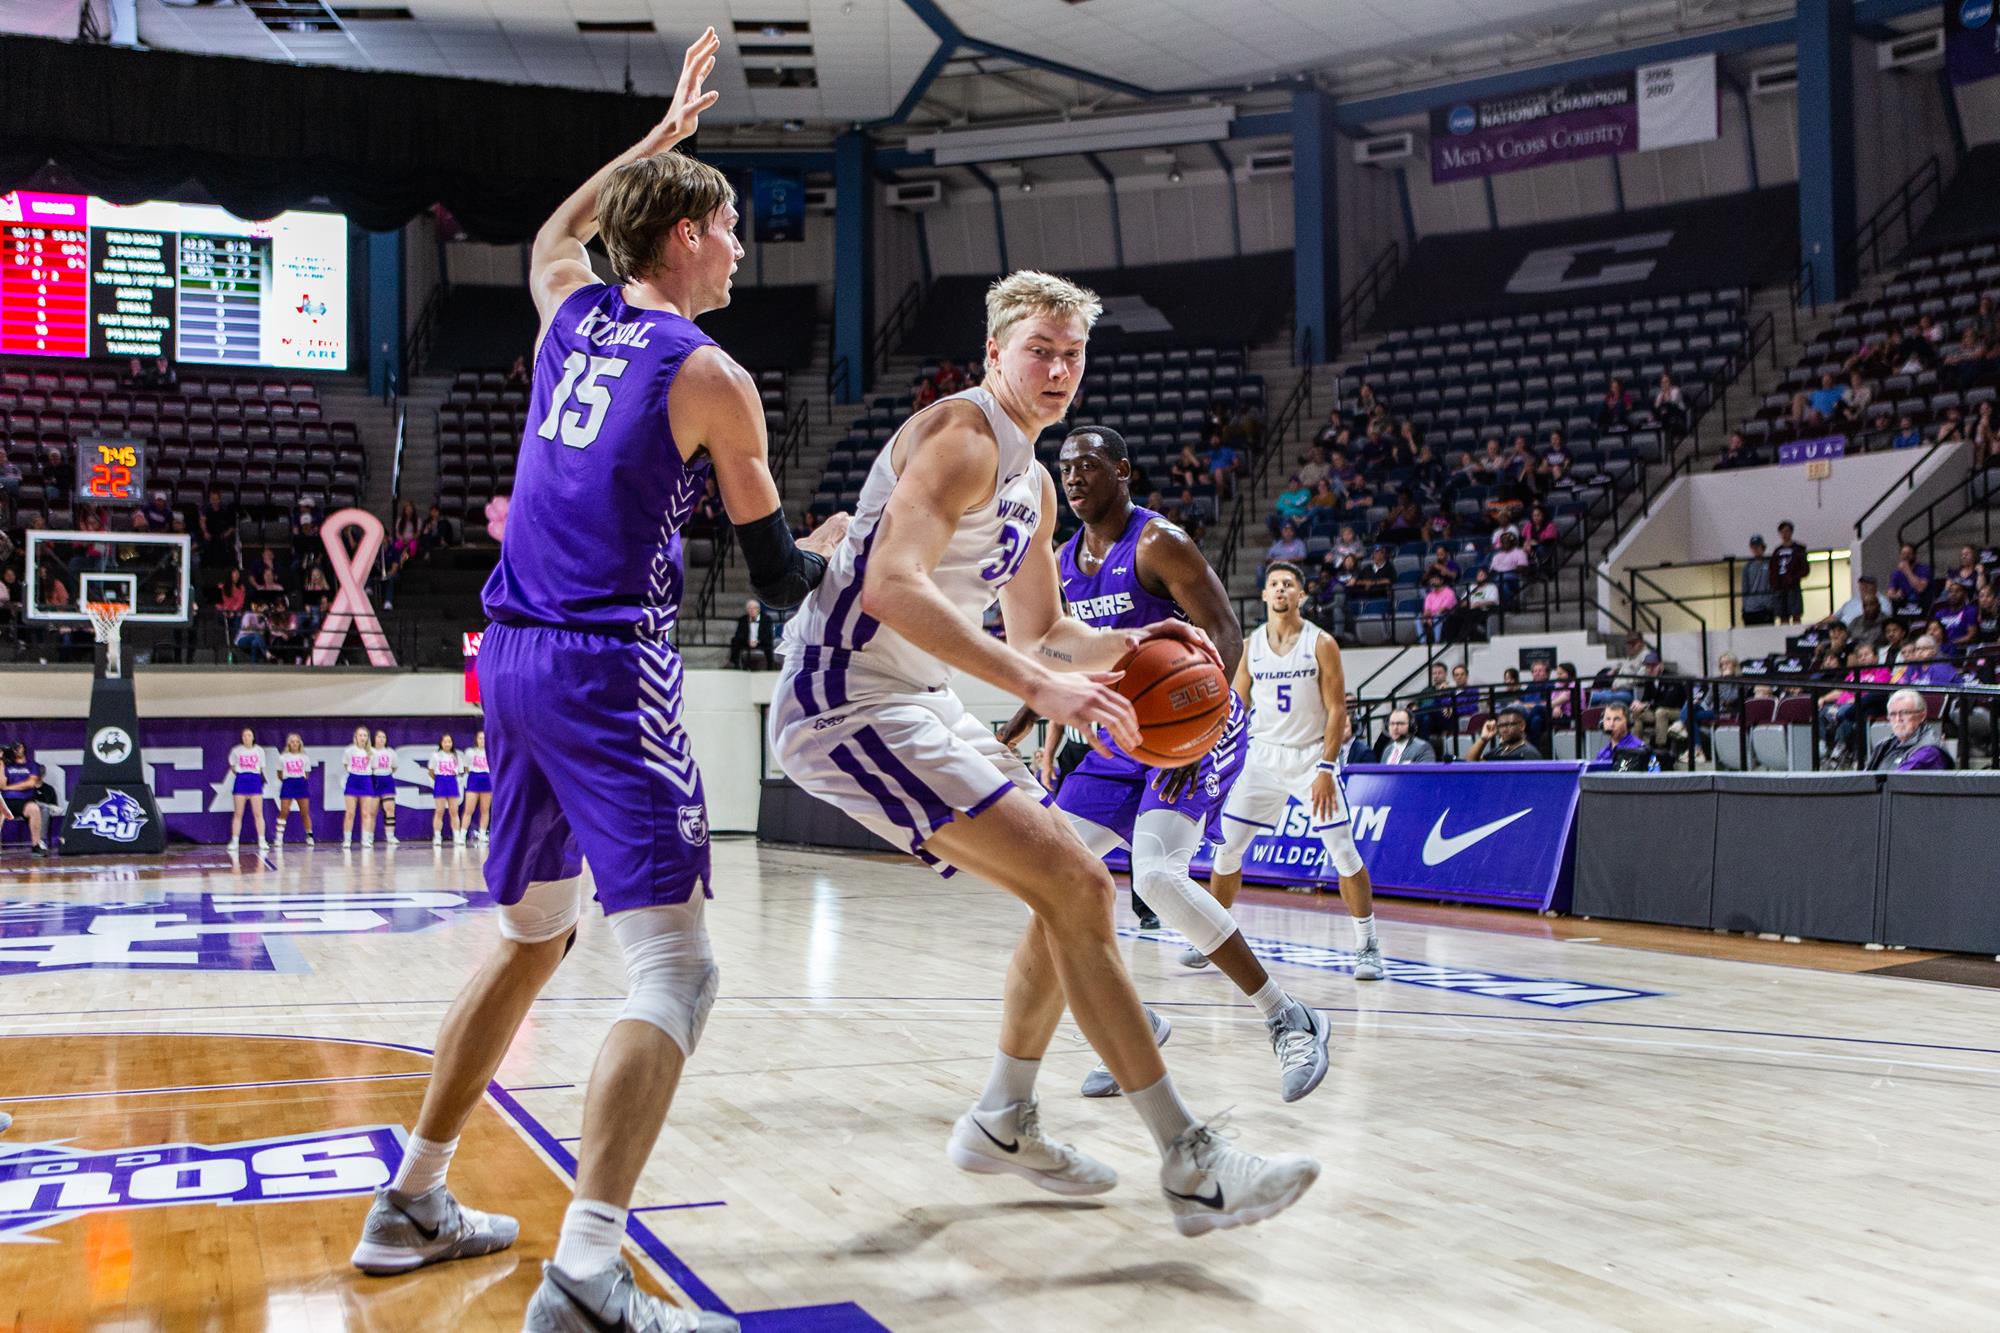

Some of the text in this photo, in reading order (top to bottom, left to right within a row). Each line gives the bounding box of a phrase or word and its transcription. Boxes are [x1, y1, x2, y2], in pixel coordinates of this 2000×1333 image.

[1481, 88, 1628, 128] NATIONAL CHAMPION
[1441, 123, 1628, 170] Men's Cross Country
[538, 350, 629, 449] 15
[90, 464, 131, 498] 22
[1254, 668, 1317, 681] WILDCATS
[1277, 684, 1292, 713] 5
[80, 806, 141, 840] ACU
[1252, 844, 1337, 869] WILDCA
